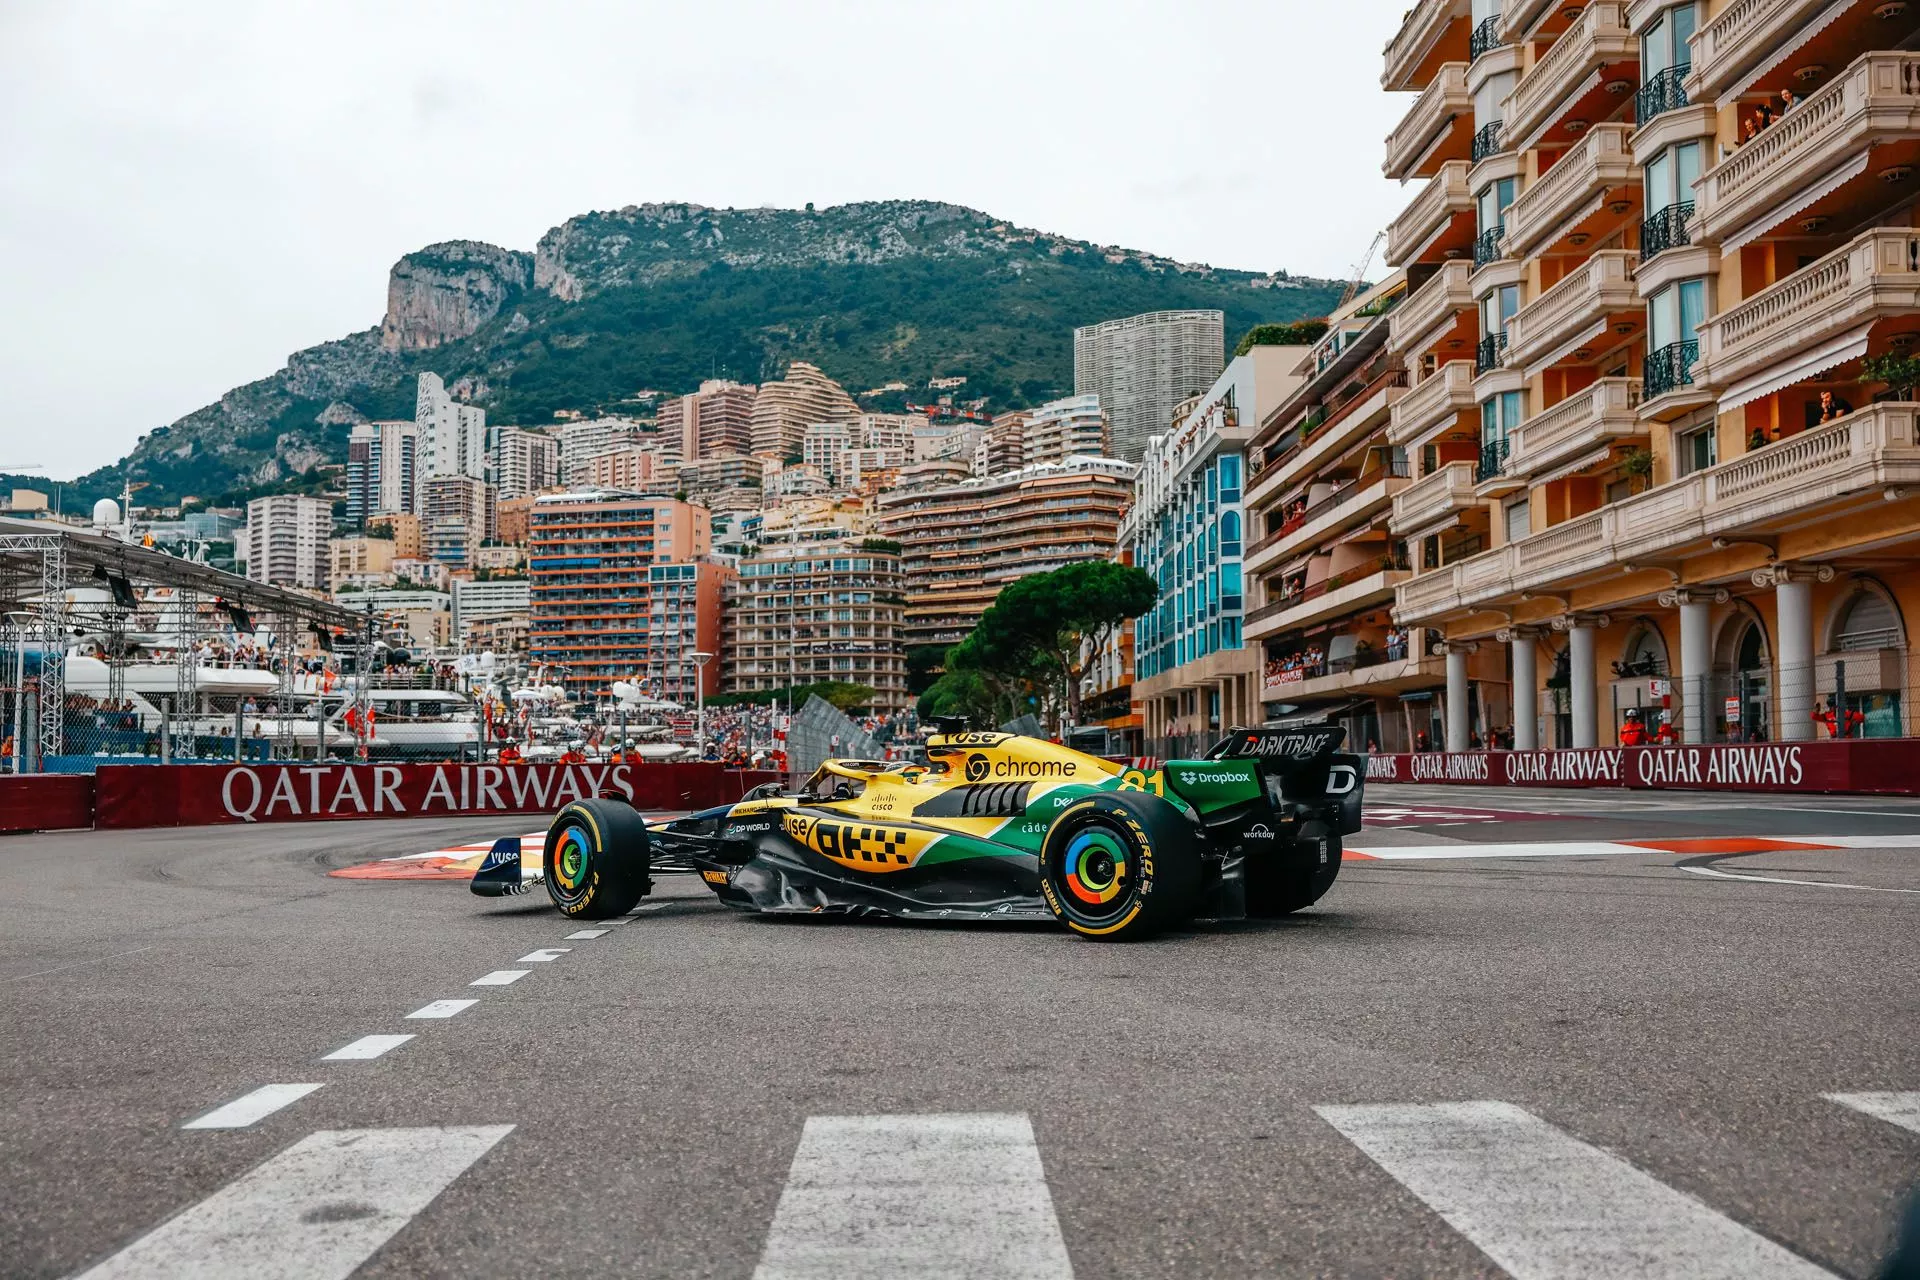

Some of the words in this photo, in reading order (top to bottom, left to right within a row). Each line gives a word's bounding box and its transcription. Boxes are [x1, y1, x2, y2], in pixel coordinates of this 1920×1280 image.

[995, 756, 1077, 776] chrome
[1411, 754, 1444, 781] QATAR
[1445, 754, 1489, 780] AIRWAYS
[1505, 753, 1548, 782] QATAR
[1550, 750, 1624, 780] AIRWAY
[1638, 749, 1702, 785] QATAR
[1706, 746, 1803, 785] AIRWAYS
[1199, 771, 1251, 785] Dropbox
[222, 766, 406, 823] QATAR
[421, 765, 634, 812] AIRWAYS
[736, 825, 746, 833] DP
[746, 823, 771, 832] WORLD
[1243, 830, 1275, 840] workday
